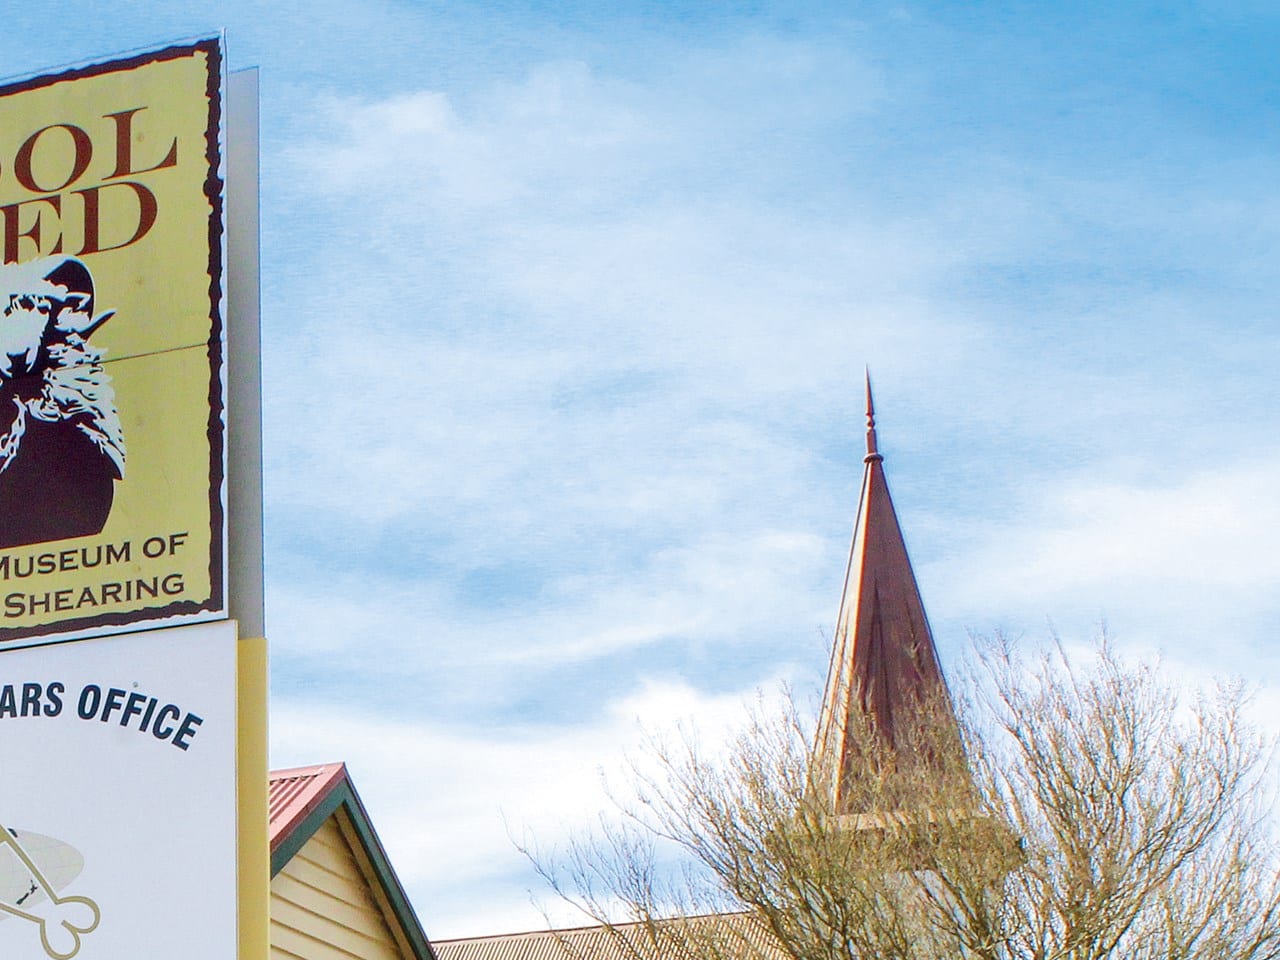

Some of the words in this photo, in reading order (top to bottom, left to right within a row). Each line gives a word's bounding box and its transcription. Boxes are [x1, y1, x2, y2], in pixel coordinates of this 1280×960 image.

[142, 533, 189, 558] OF
[3, 573, 186, 619] SHEARING
[78, 683, 205, 751] OFFICE
